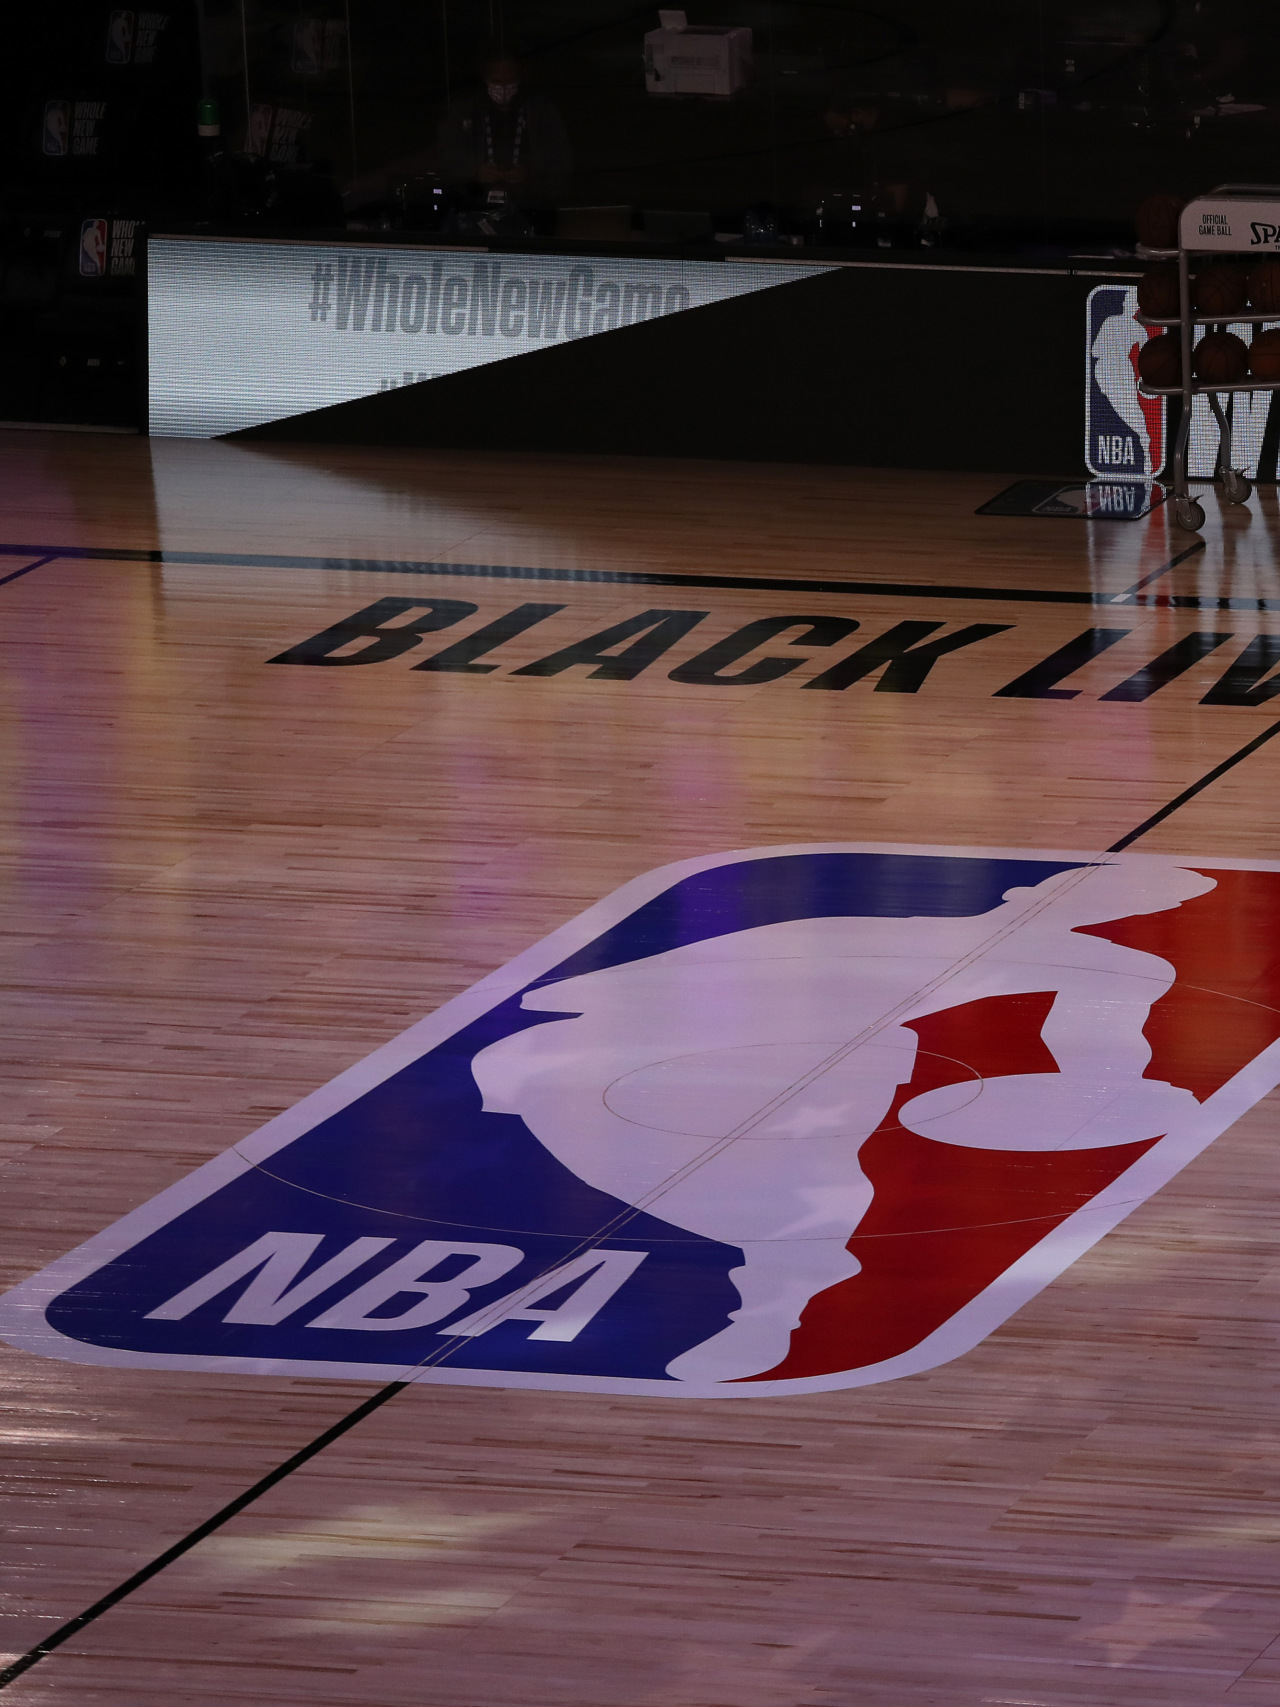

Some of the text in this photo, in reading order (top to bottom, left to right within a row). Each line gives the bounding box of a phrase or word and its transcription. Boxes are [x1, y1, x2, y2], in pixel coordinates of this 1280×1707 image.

[74, 102, 107, 119] WHOLE
[73, 120, 96, 136] NEW
[72, 137, 99, 155] GAME
[1202, 214, 1228, 225] OFFICIAL
[112, 219, 146, 239] WHO
[1199, 224, 1232, 236] GAME BALL
[111, 238, 135, 257] NEW
[1098, 435, 1135, 465] NBA
[265, 597, 1016, 693] BLACK
[143, 1231, 649, 1342] NBA
